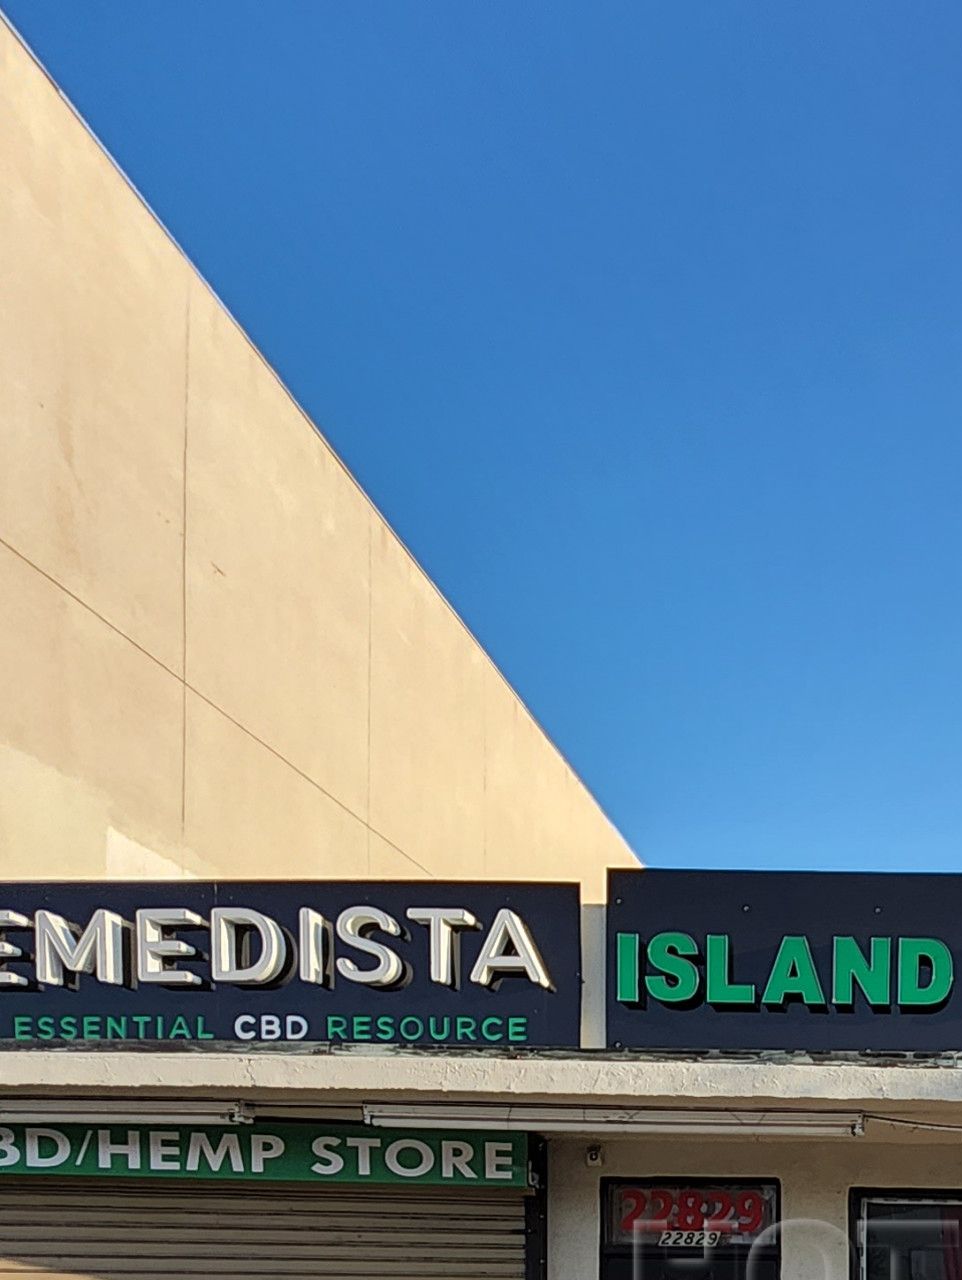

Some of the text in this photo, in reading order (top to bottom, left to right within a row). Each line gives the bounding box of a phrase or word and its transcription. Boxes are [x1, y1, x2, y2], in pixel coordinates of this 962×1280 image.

[616, 931, 953, 1006] ISLAND
[13, 1015, 528, 1042] ESSENTIAL CBD RESOURCE
[310, 1136, 514, 1180] STORE
[621, 1188, 764, 1233] 22829
[660, 1231, 720, 1246] 22829
